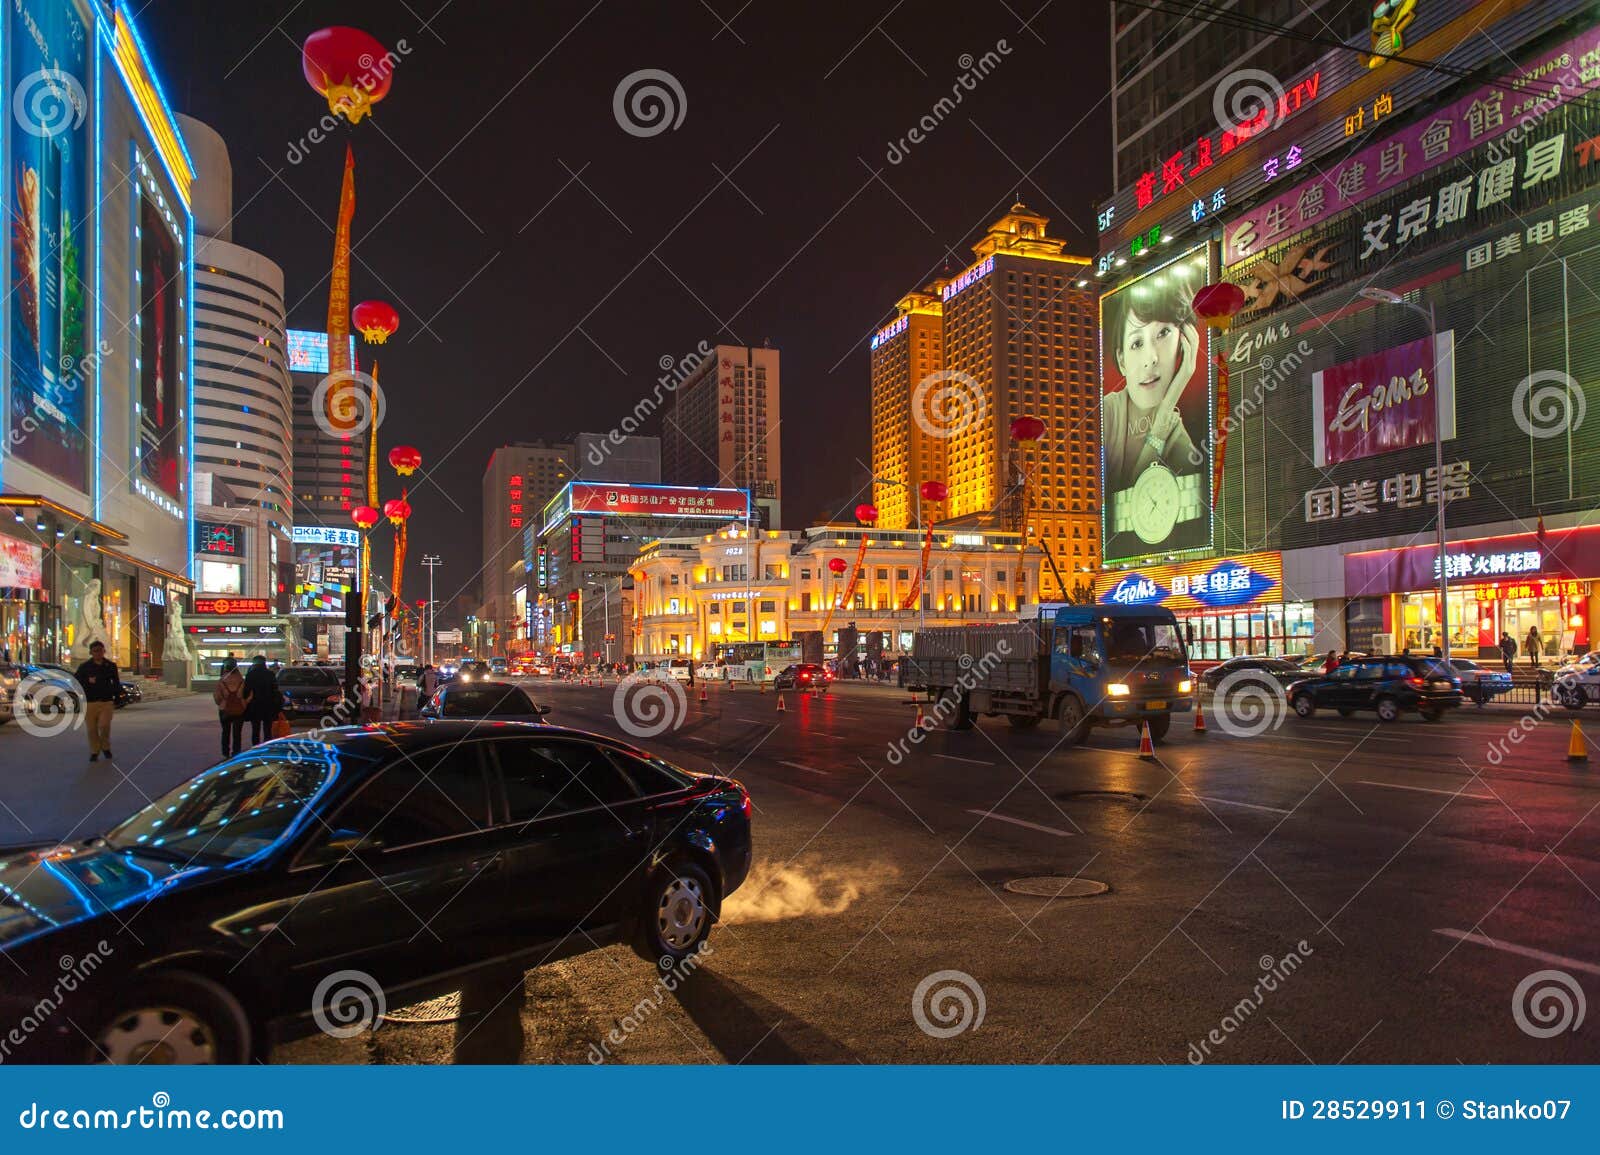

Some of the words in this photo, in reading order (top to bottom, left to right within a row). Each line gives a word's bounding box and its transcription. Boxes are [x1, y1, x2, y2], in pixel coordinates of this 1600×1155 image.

[1345, 91, 1393, 136] 时尚
[1263, 145, 1303, 182] 安全
[1192, 187, 1227, 222] 快乐
[1360, 133, 1564, 260] 艾克斯健身
[1098, 206, 1115, 231] 5F
[1466, 203, 1590, 270] 国美电器
[1304, 460, 1470, 523] 国美电器
[1171, 567, 1250, 596] 国美电器
